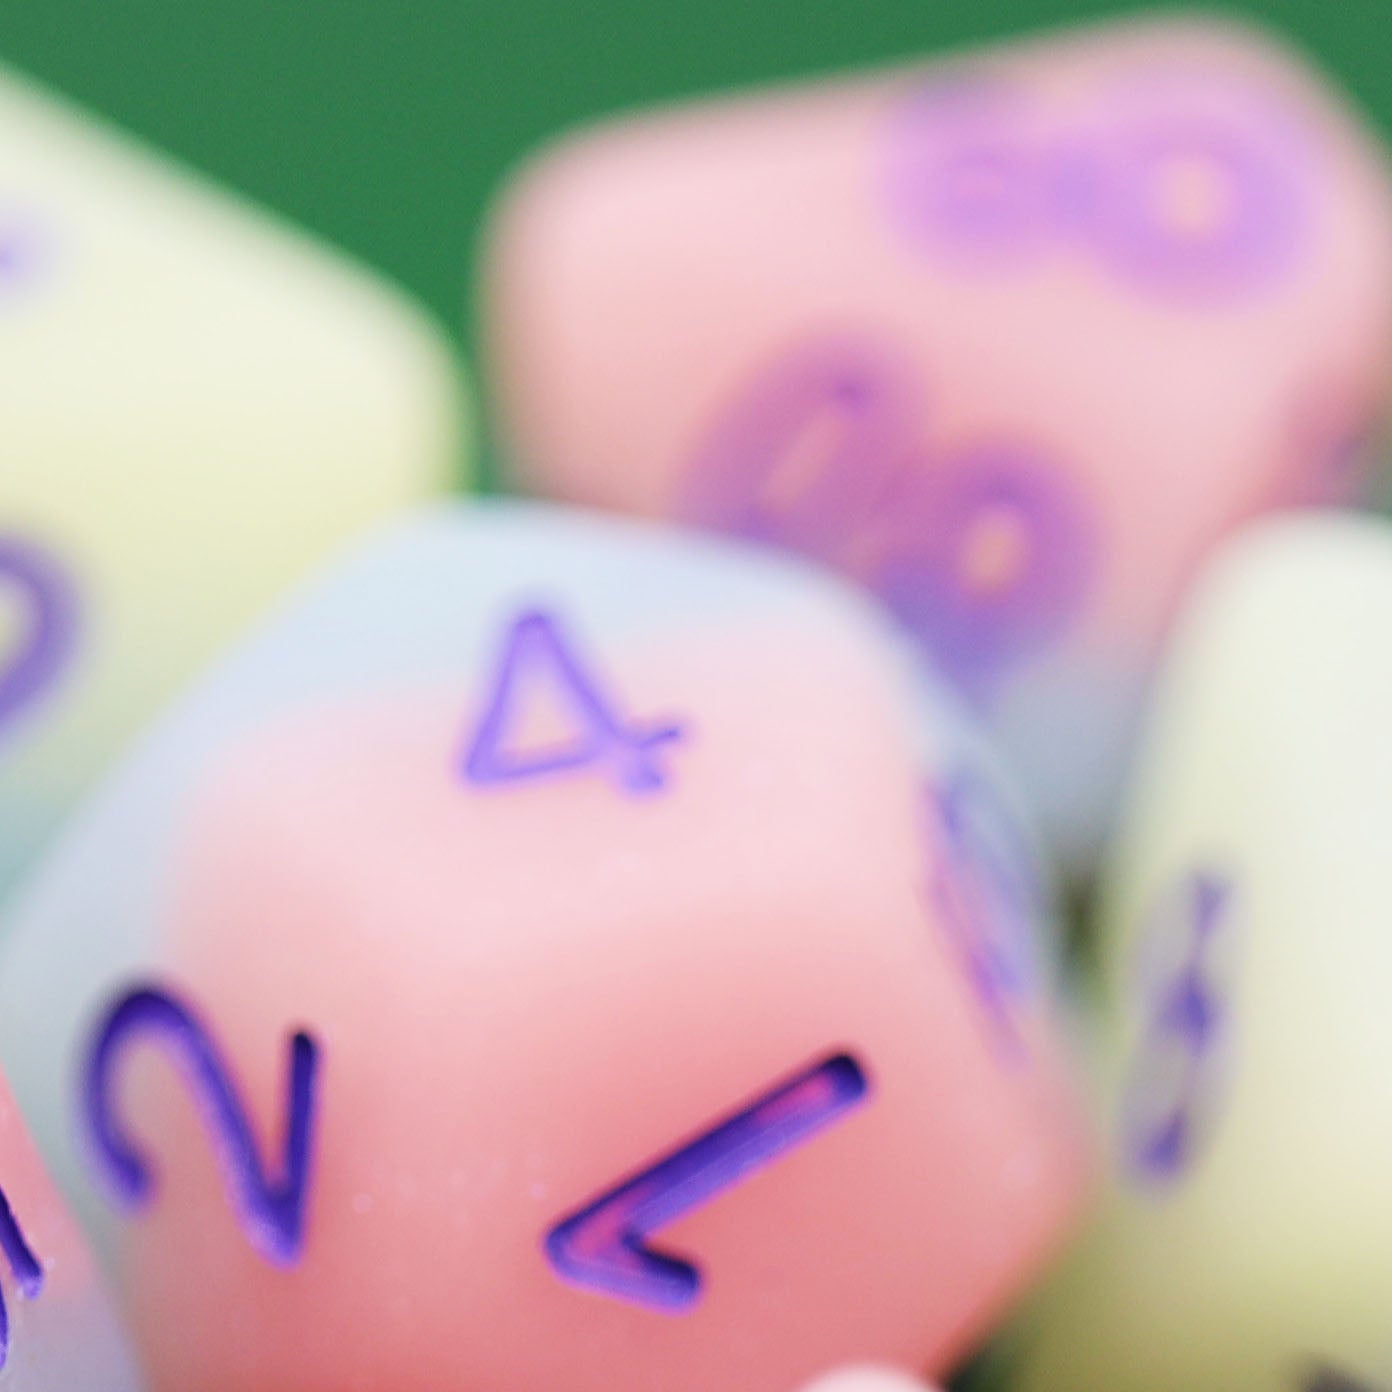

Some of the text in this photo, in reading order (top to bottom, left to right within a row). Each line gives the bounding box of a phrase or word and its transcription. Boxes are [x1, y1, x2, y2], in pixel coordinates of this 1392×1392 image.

[458, 607, 693, 797] 4
[73, 973, 322, 1270] 2
[543, 1046, 872, 1318] 1
